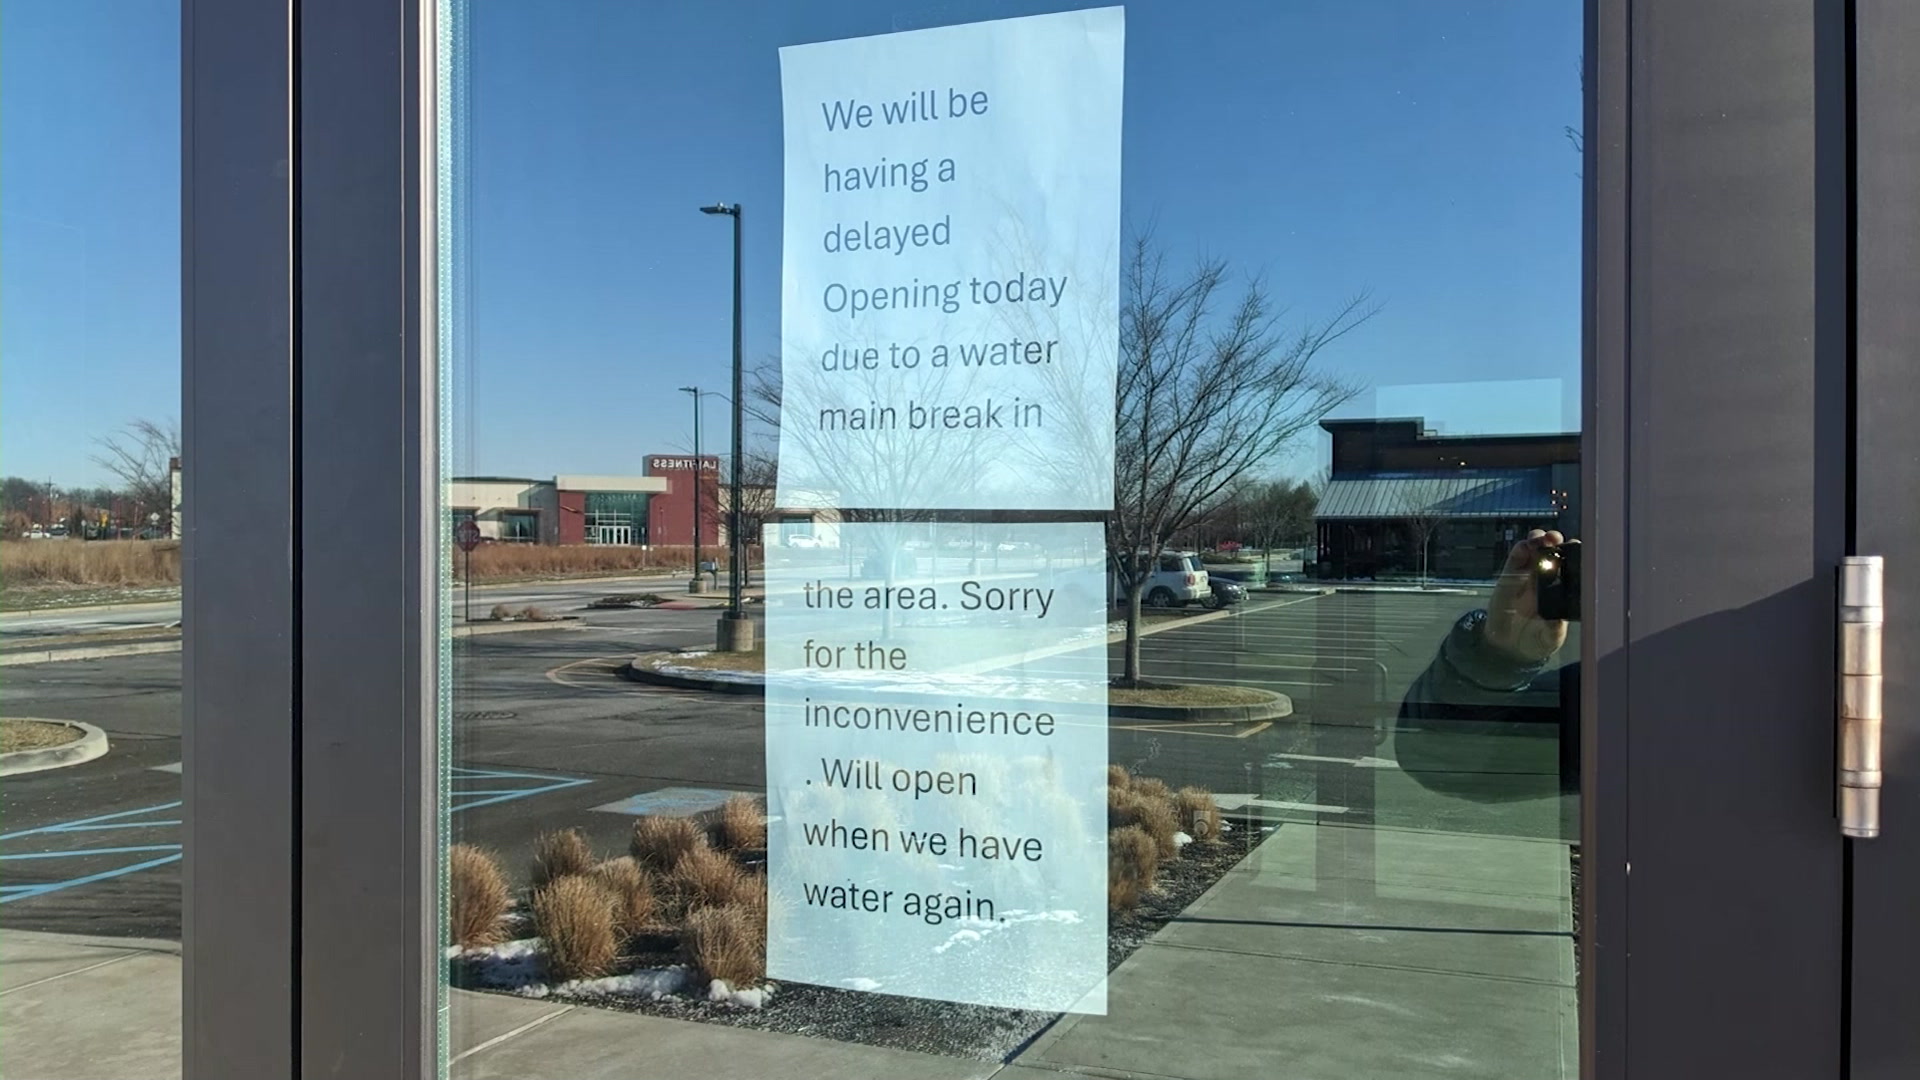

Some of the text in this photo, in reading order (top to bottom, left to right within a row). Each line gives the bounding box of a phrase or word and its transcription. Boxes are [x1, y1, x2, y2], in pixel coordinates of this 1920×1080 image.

[822, 88, 989, 132] We will be
[824, 157, 956, 193] having a
[823, 214, 951, 256] delayed
[823, 272, 1068, 319] Opening today
[821, 337, 1059, 372] due to a water
[819, 397, 1042, 431] main break in
[803, 580, 1055, 618] the area. Sorry
[803, 639, 907, 670] for the
[804, 697, 1056, 736] inconvenience
[821, 757, 882, 791] Will
[892, 766, 977, 800] open
[803, 819, 1043, 862] when we have
[803, 882, 1007, 925] water again.
